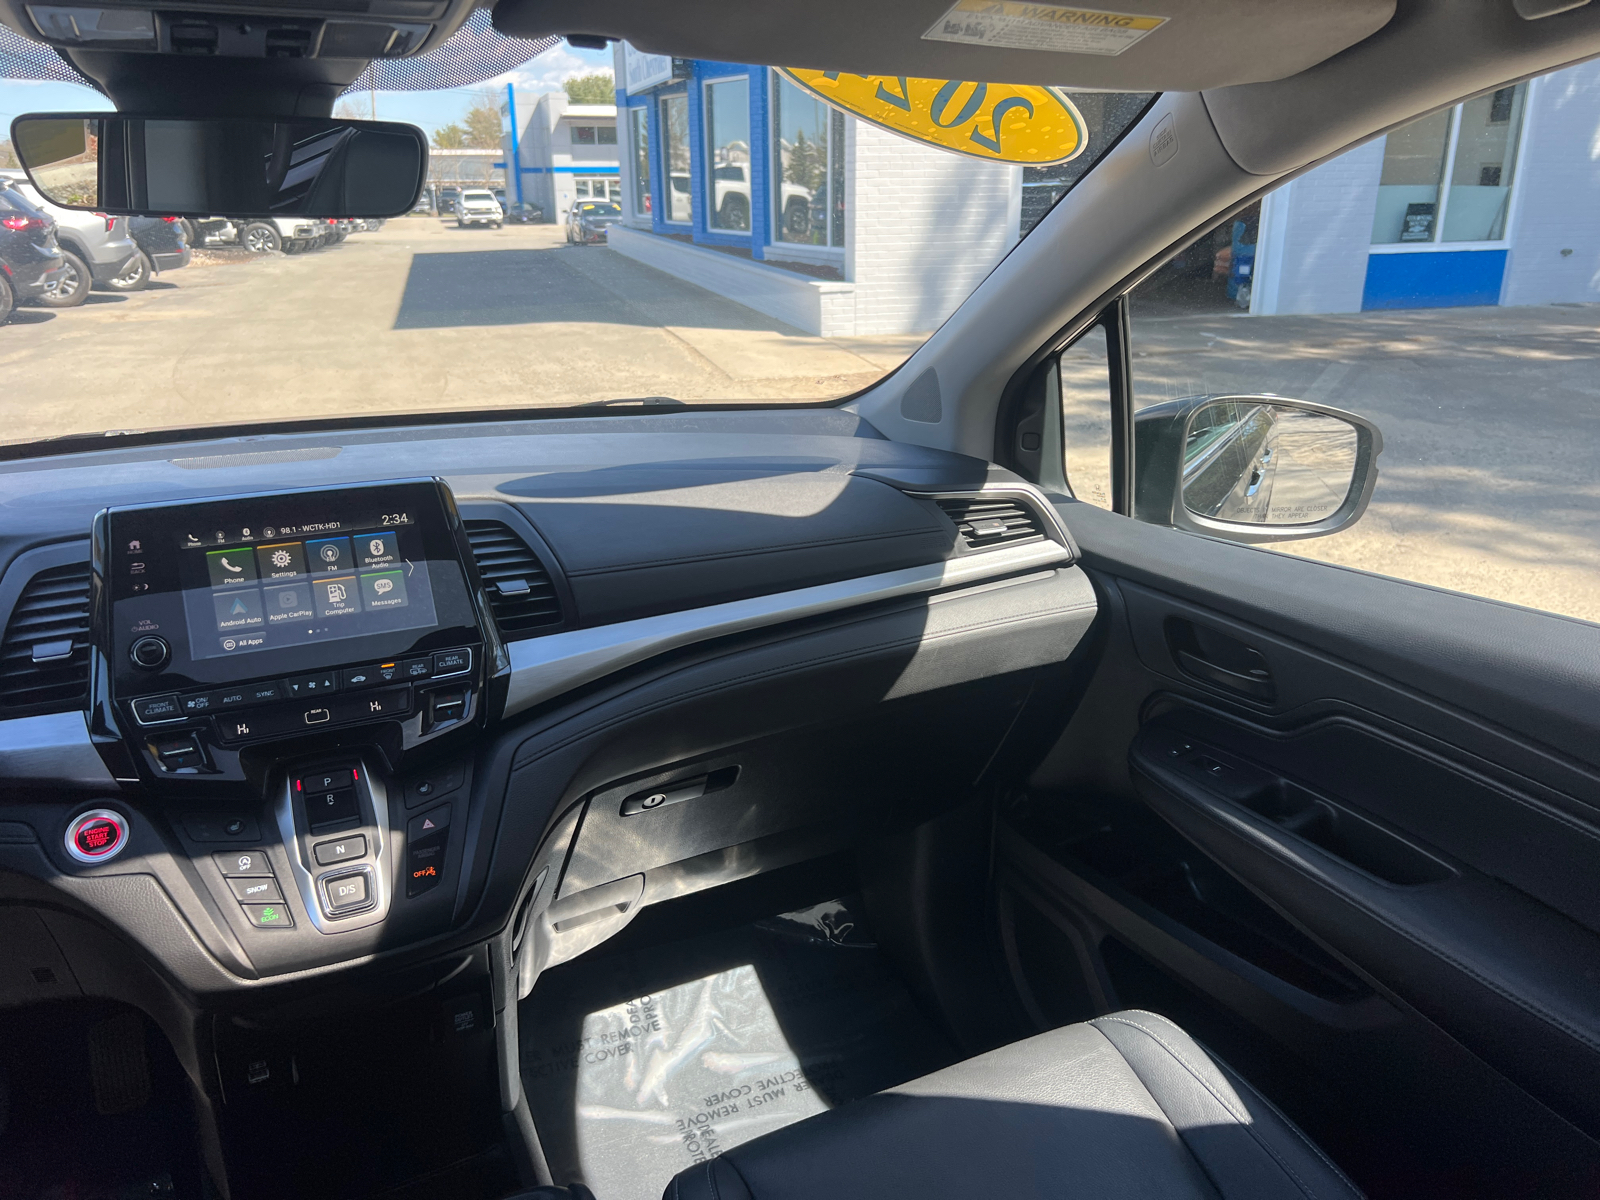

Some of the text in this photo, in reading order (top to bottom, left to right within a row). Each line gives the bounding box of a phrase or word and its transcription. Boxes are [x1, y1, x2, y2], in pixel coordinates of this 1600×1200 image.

[1021, 6, 1134, 27] WARNING
[381, 513, 409, 526] 2:34
[280, 526, 297, 535] 98.1
[302, 521, 341, 533] WCTK-HD1
[364, 554, 394, 564] Bluetooth
[371, 561, 389, 569] Audio
[271, 570, 298, 579] Settings
[224, 576, 245, 585] Phone
[376, 582, 392, 591] SMS
[333, 601, 345, 609] Trip
[371, 597, 402, 607] Messages
[269, 609, 313, 622] Apple CarPlay
[325, 606, 355, 617] Computer
[220, 616, 262, 628] Android Auto
[138, 623, 160, 632] AUDIO
[248, 638, 264, 647] Apps
[438, 658, 464, 668] CLIMATE
[445, 654, 459, 662] REAR
[223, 695, 242, 703] AUTO
[256, 690, 275, 698] SYNC
[195, 696, 209, 704] ON/
[196, 701, 210, 709] OFF
[144, 705, 175, 716] CLIMATE
[148, 701, 170, 710] FRONT
[323, 777, 332, 787] P
[326, 794, 335, 803] R
[84, 826, 110, 837] ENGINE
[86, 832, 108, 842] START
[89, 839, 108, 848] STOP
[335, 844, 346, 855] N
[239, 863, 252, 871] OFF
[413, 869, 427, 878] OFF
[246, 883, 268, 895] SNOW
[338, 884, 356, 897] D/S
[261, 913, 280, 923] ECON
[551, 1036, 593, 1057] MUST
[600, 1019, 662, 1046] REMOVE
[585, 1041, 635, 1065] COVER
[703, 1084, 752, 1107] COVER
[746, 1086, 785, 1109] MUST
[675, 1103, 739, 1131] REMOVE
